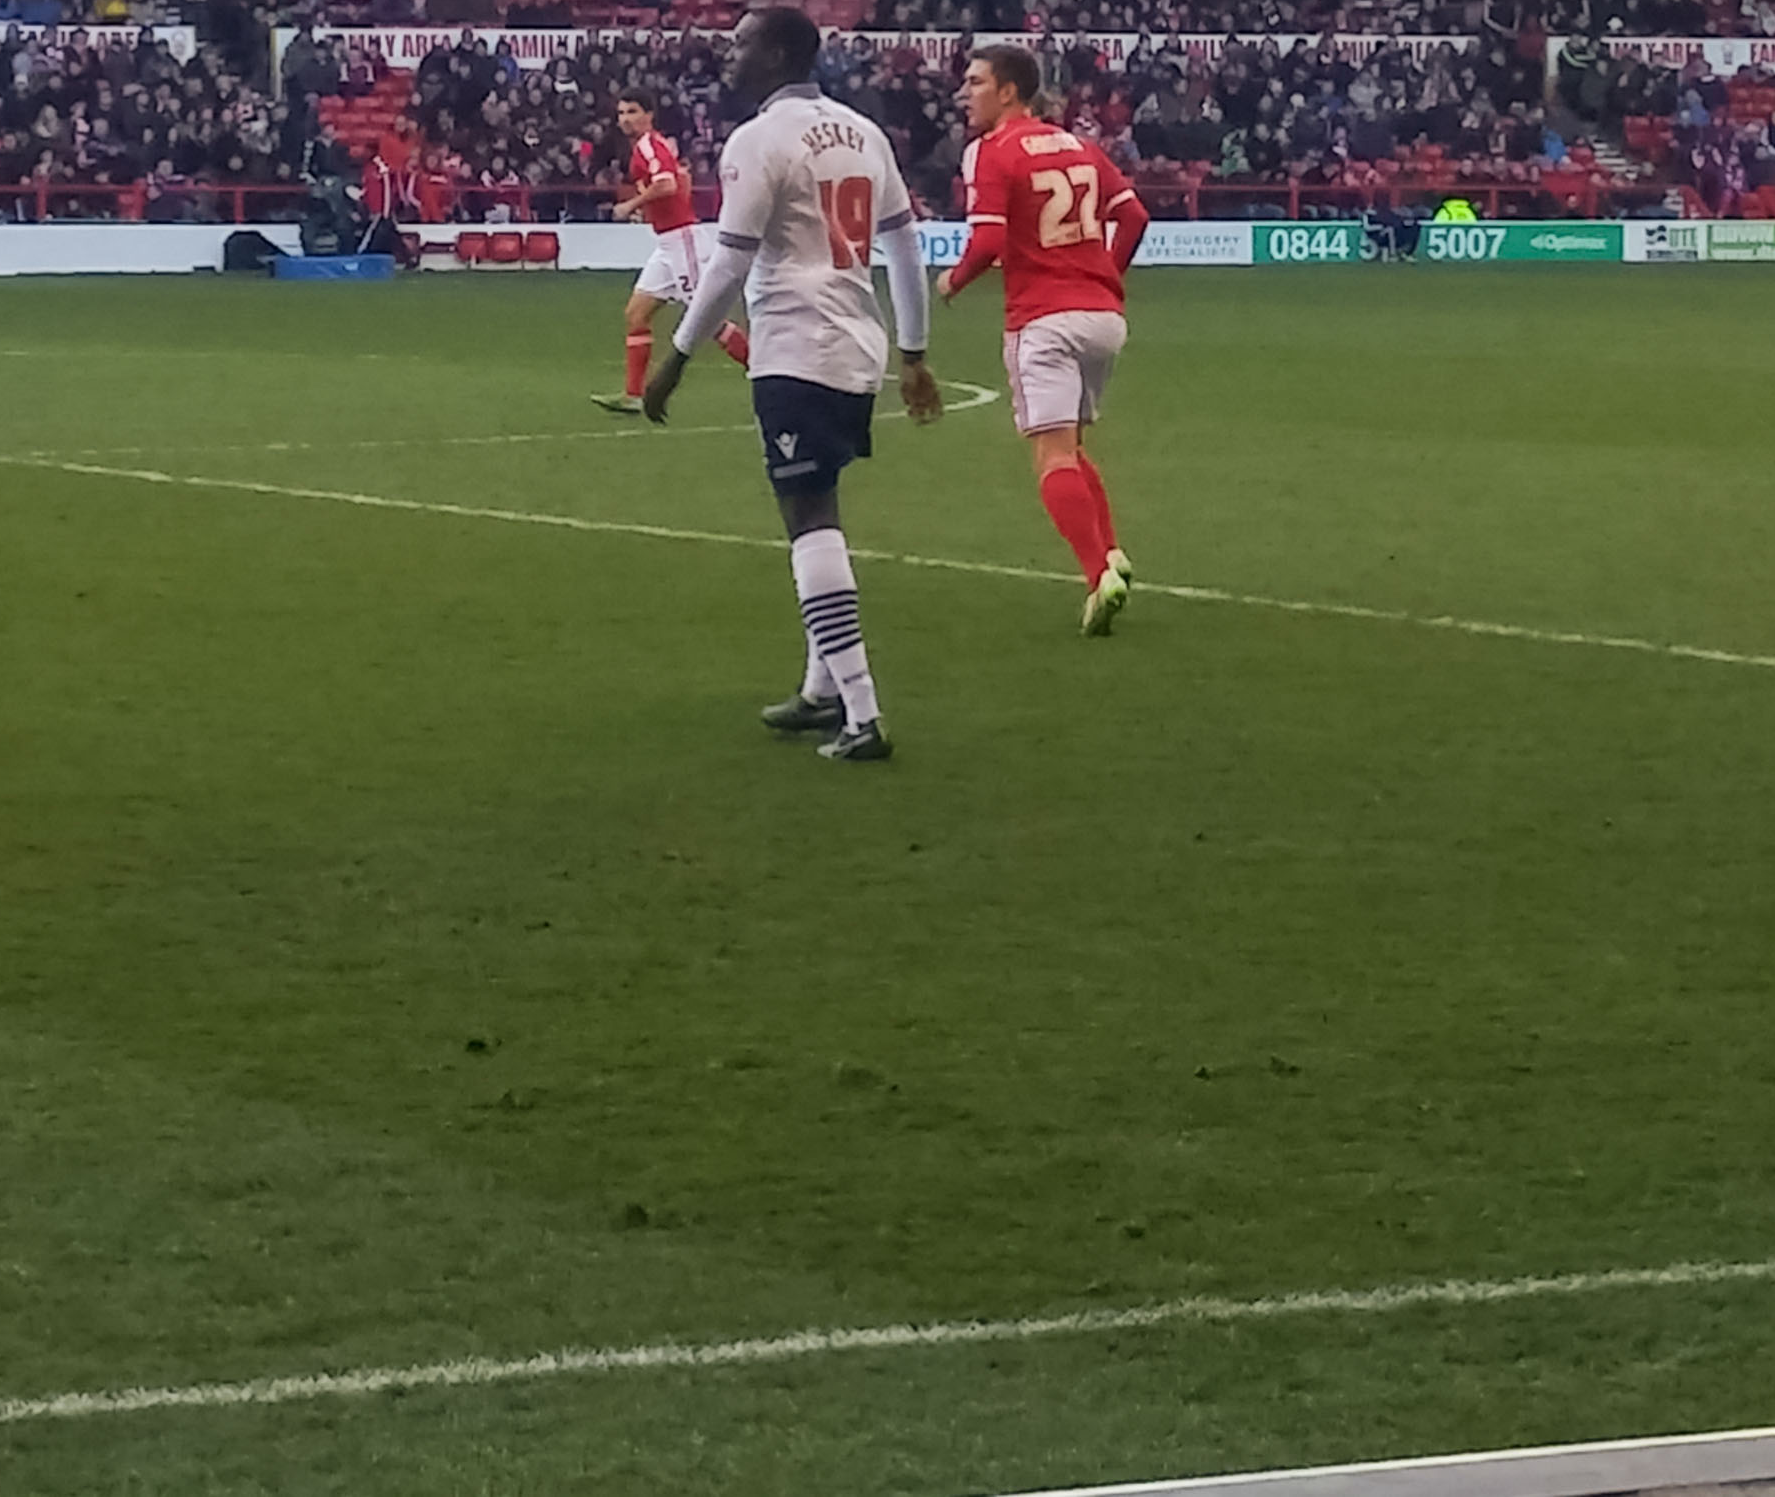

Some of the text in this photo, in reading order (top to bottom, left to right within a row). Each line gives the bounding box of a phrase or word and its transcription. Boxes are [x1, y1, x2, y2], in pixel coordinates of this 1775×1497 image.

[801, 122, 864, 157] HESKEY
[1030, 164, 1104, 249] 27
[1174, 235, 1240, 246] SURGERY
[1269, 228, 1350, 260] 0844
[1427, 227, 1507, 260] 5007
